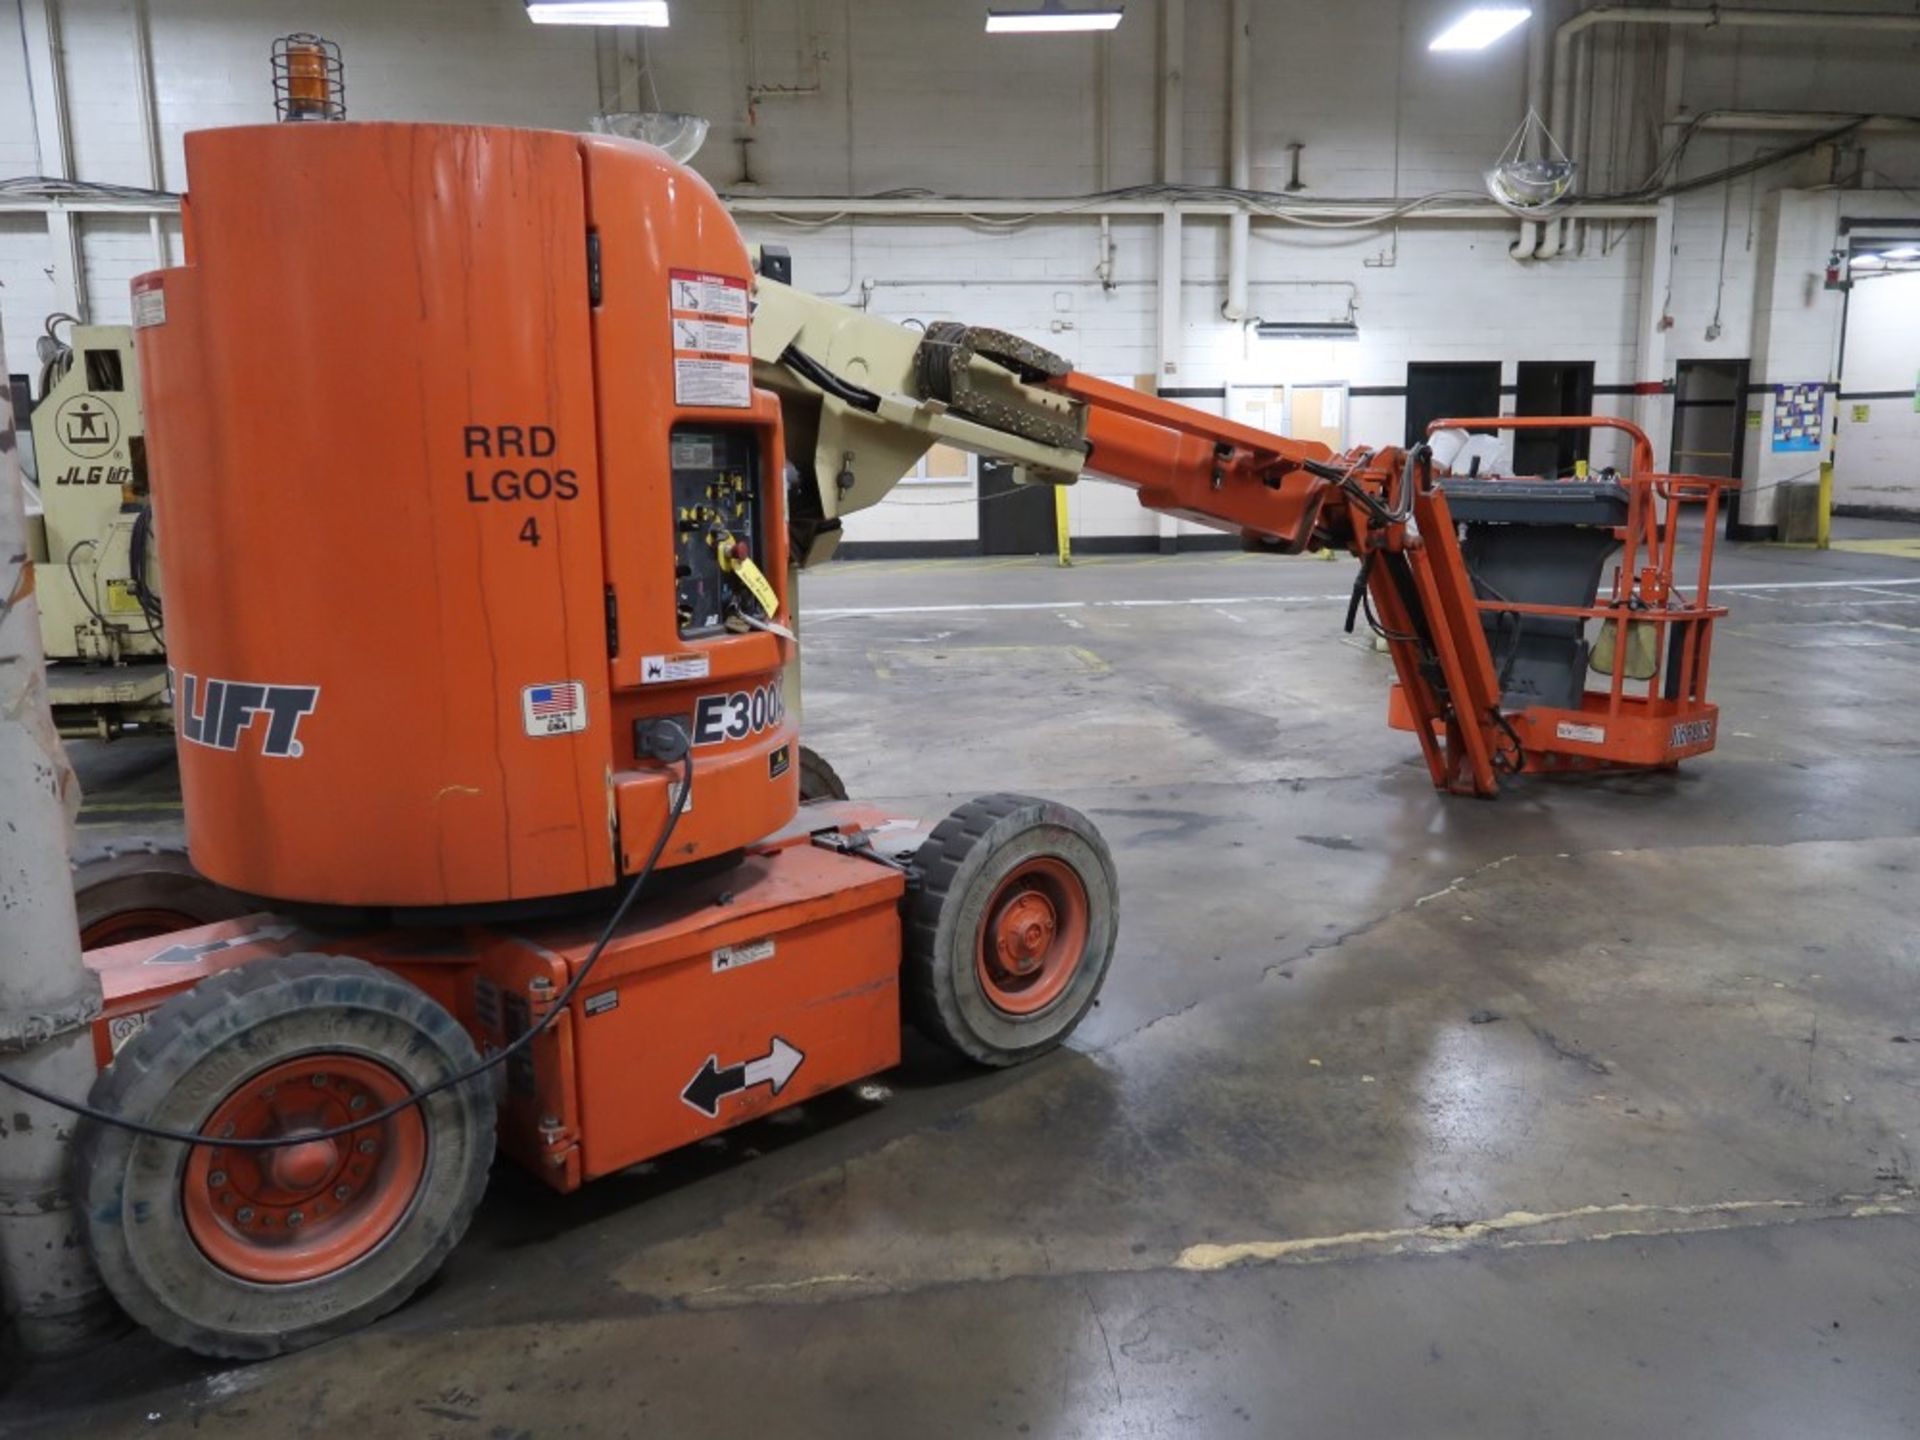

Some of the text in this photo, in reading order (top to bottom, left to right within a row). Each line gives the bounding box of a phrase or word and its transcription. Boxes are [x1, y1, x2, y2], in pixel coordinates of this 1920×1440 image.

[464, 425, 556, 458] RRD
[57, 466, 103, 485] JLG
[466, 468, 579, 502] LGOS
[519, 517, 542, 547] 4
